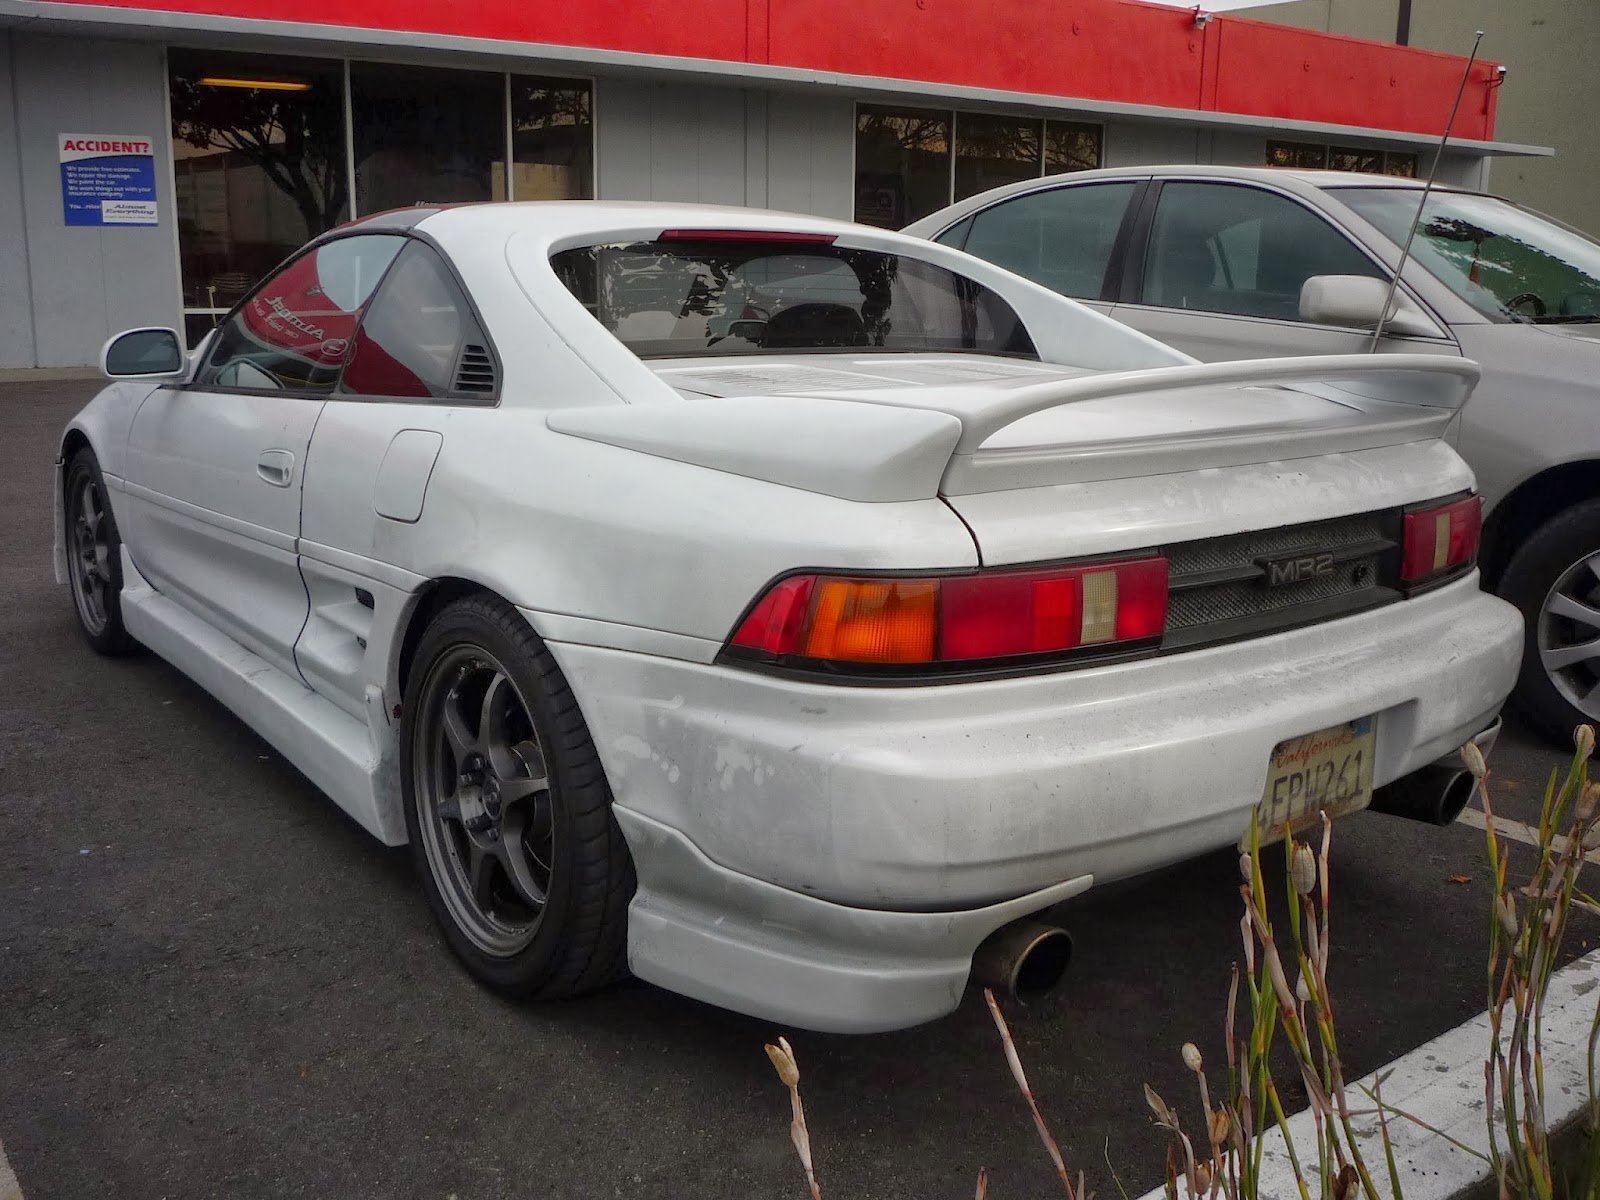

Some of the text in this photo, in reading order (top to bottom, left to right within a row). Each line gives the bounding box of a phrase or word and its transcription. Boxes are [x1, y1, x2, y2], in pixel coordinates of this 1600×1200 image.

[64, 140, 149, 153] ACCIDENT?
[1271, 554, 1333, 585] MR2
[1277, 731, 1354, 769] California
